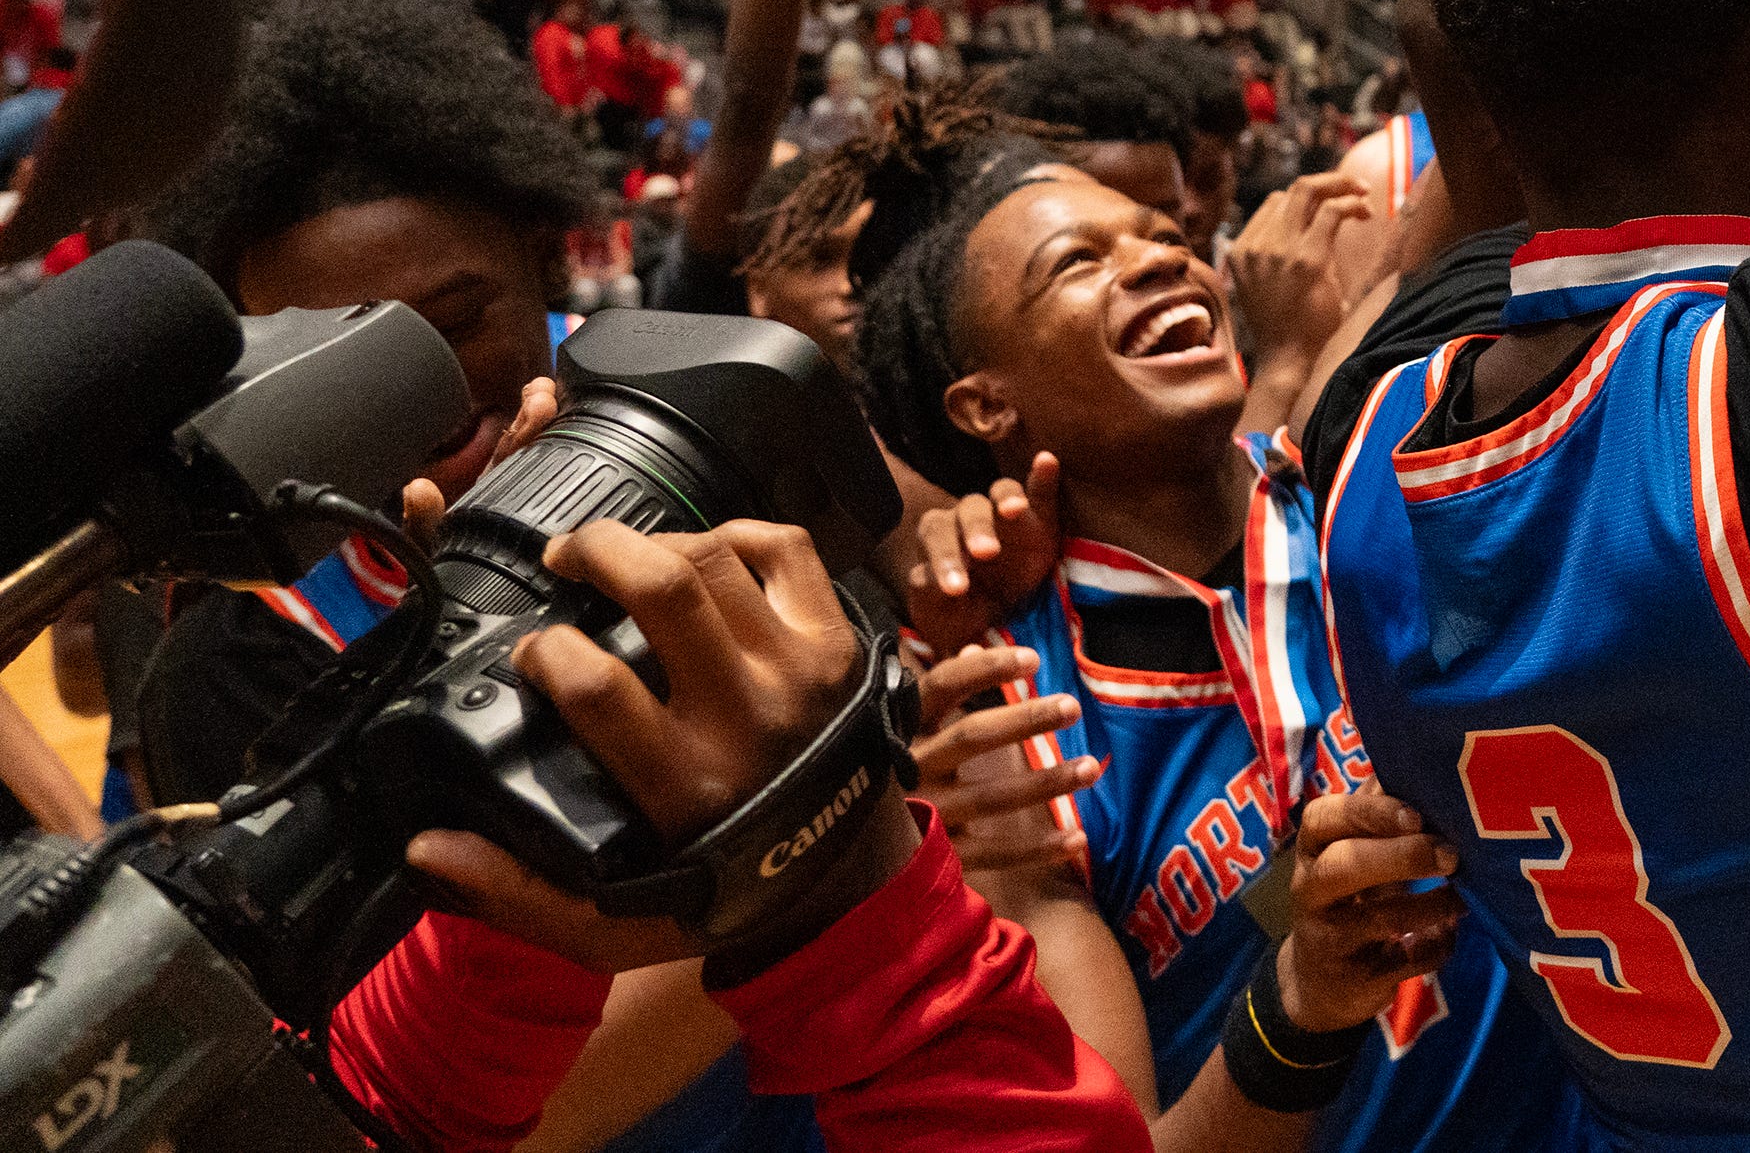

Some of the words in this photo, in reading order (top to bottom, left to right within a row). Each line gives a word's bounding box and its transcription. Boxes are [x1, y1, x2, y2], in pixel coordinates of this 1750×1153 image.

[759, 765, 871, 879] Canon
[1457, 723, 1733, 1070] 3
[33, 1040, 141, 1151] LDX
